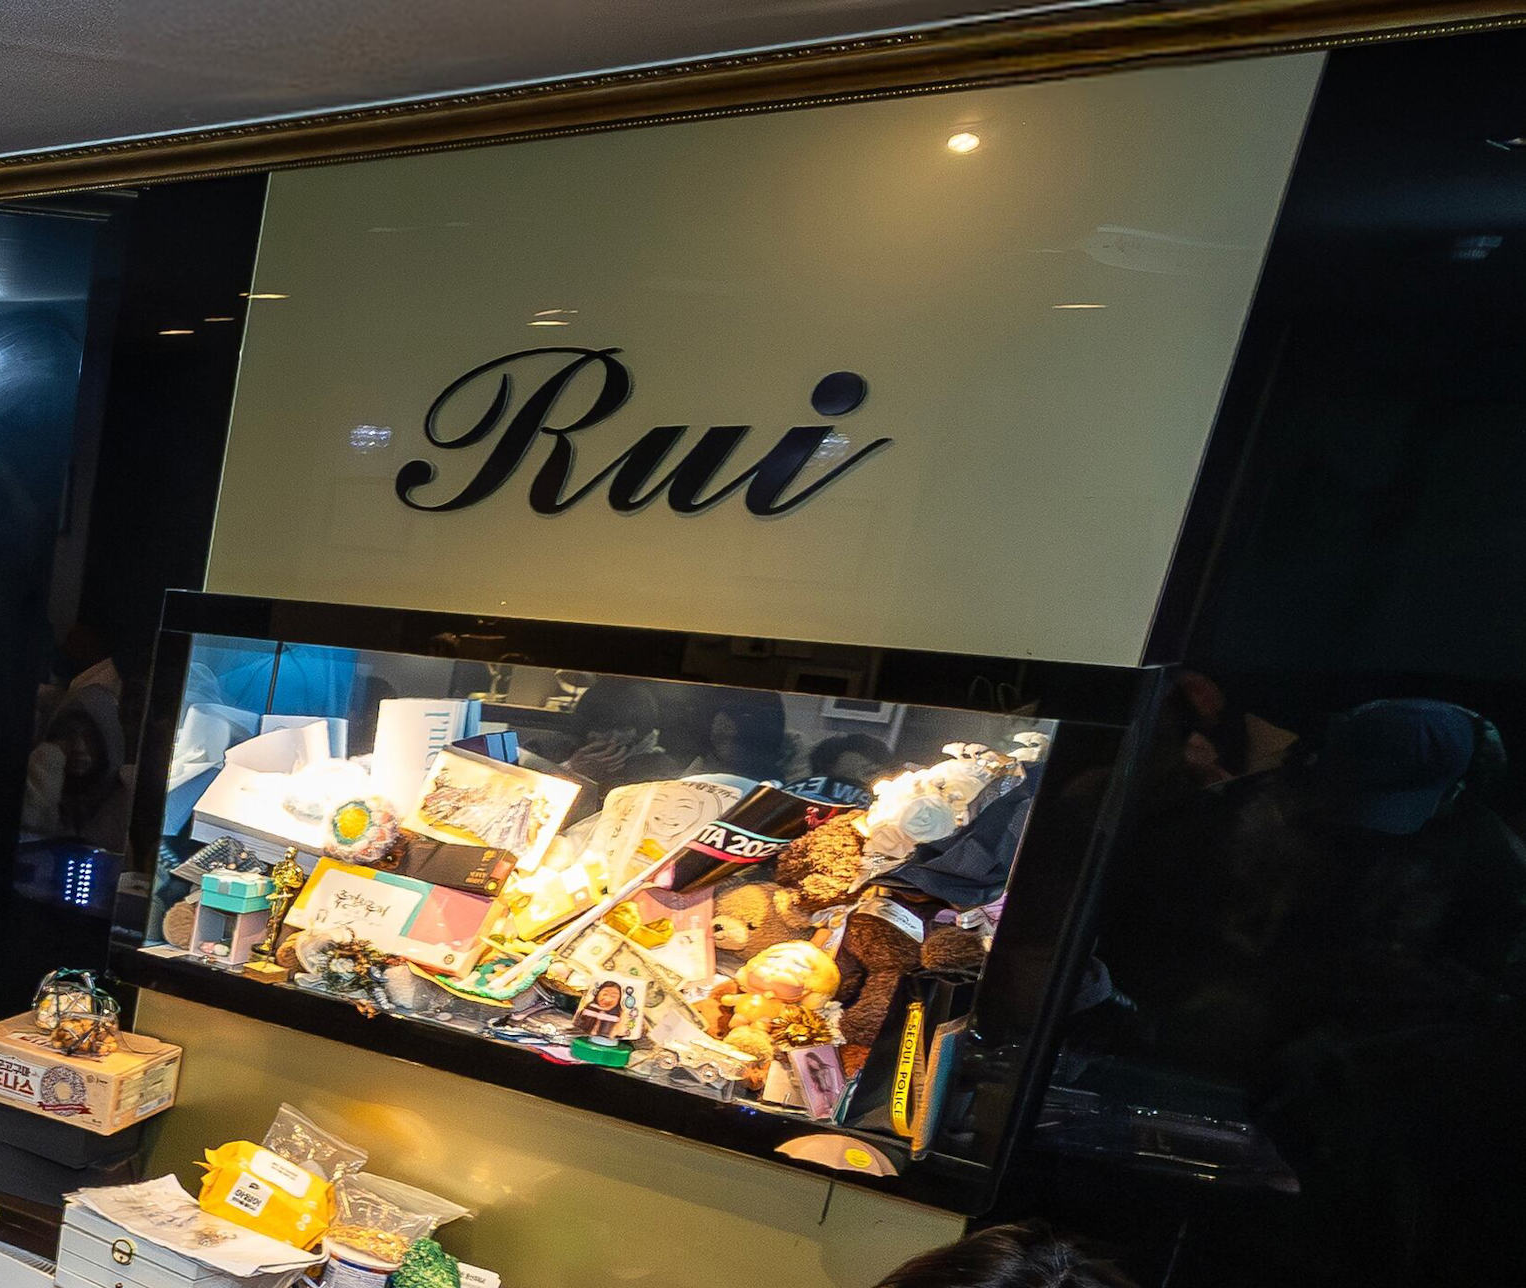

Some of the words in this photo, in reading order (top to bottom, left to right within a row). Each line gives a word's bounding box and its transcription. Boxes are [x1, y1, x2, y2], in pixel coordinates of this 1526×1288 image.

[395, 346, 894, 518] Rui
[901, 1023, 917, 1064] SEOUL
[893, 1072, 908, 1115] POLICE
